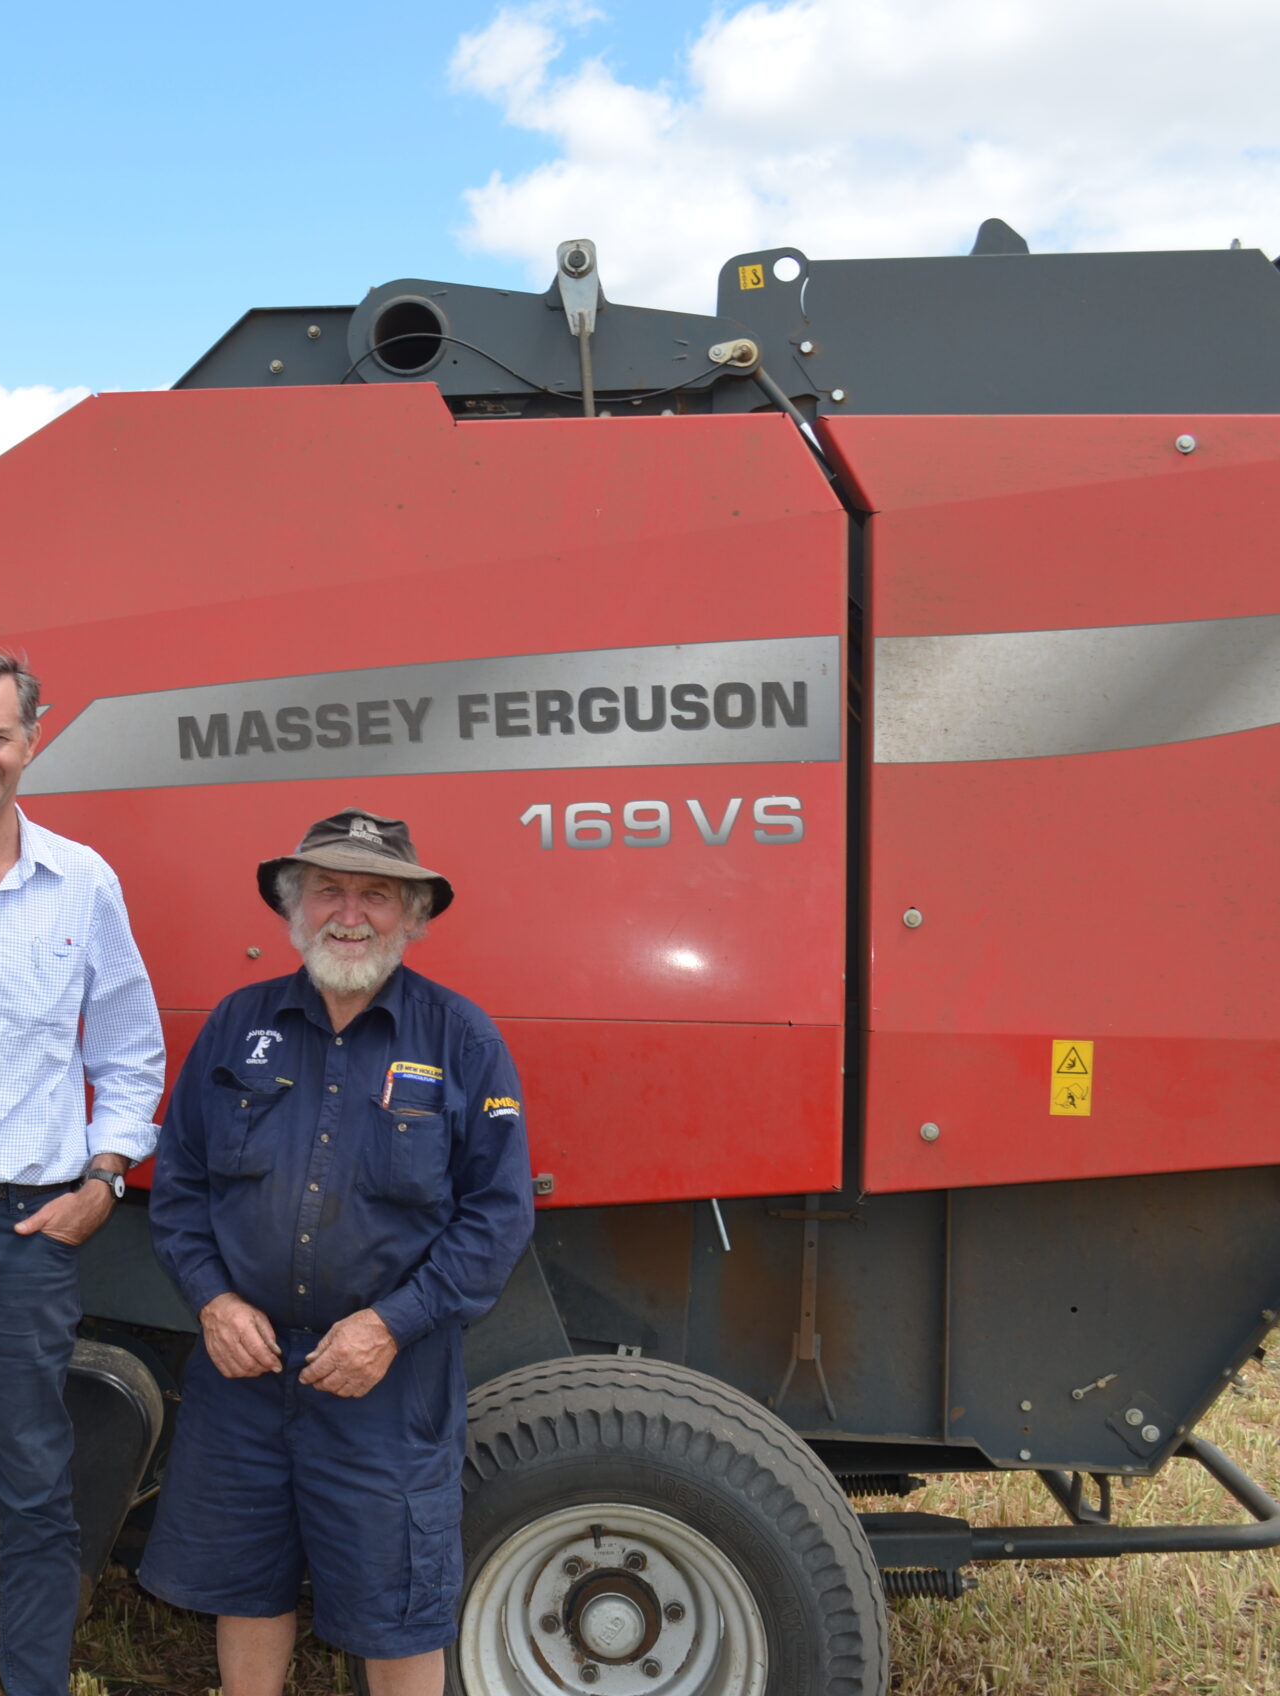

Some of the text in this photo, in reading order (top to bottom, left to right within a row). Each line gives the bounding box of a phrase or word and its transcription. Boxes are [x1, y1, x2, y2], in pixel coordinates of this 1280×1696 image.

[177, 681, 808, 760] MASSEY FERGUSON
[519, 796, 805, 850] 169 VS
